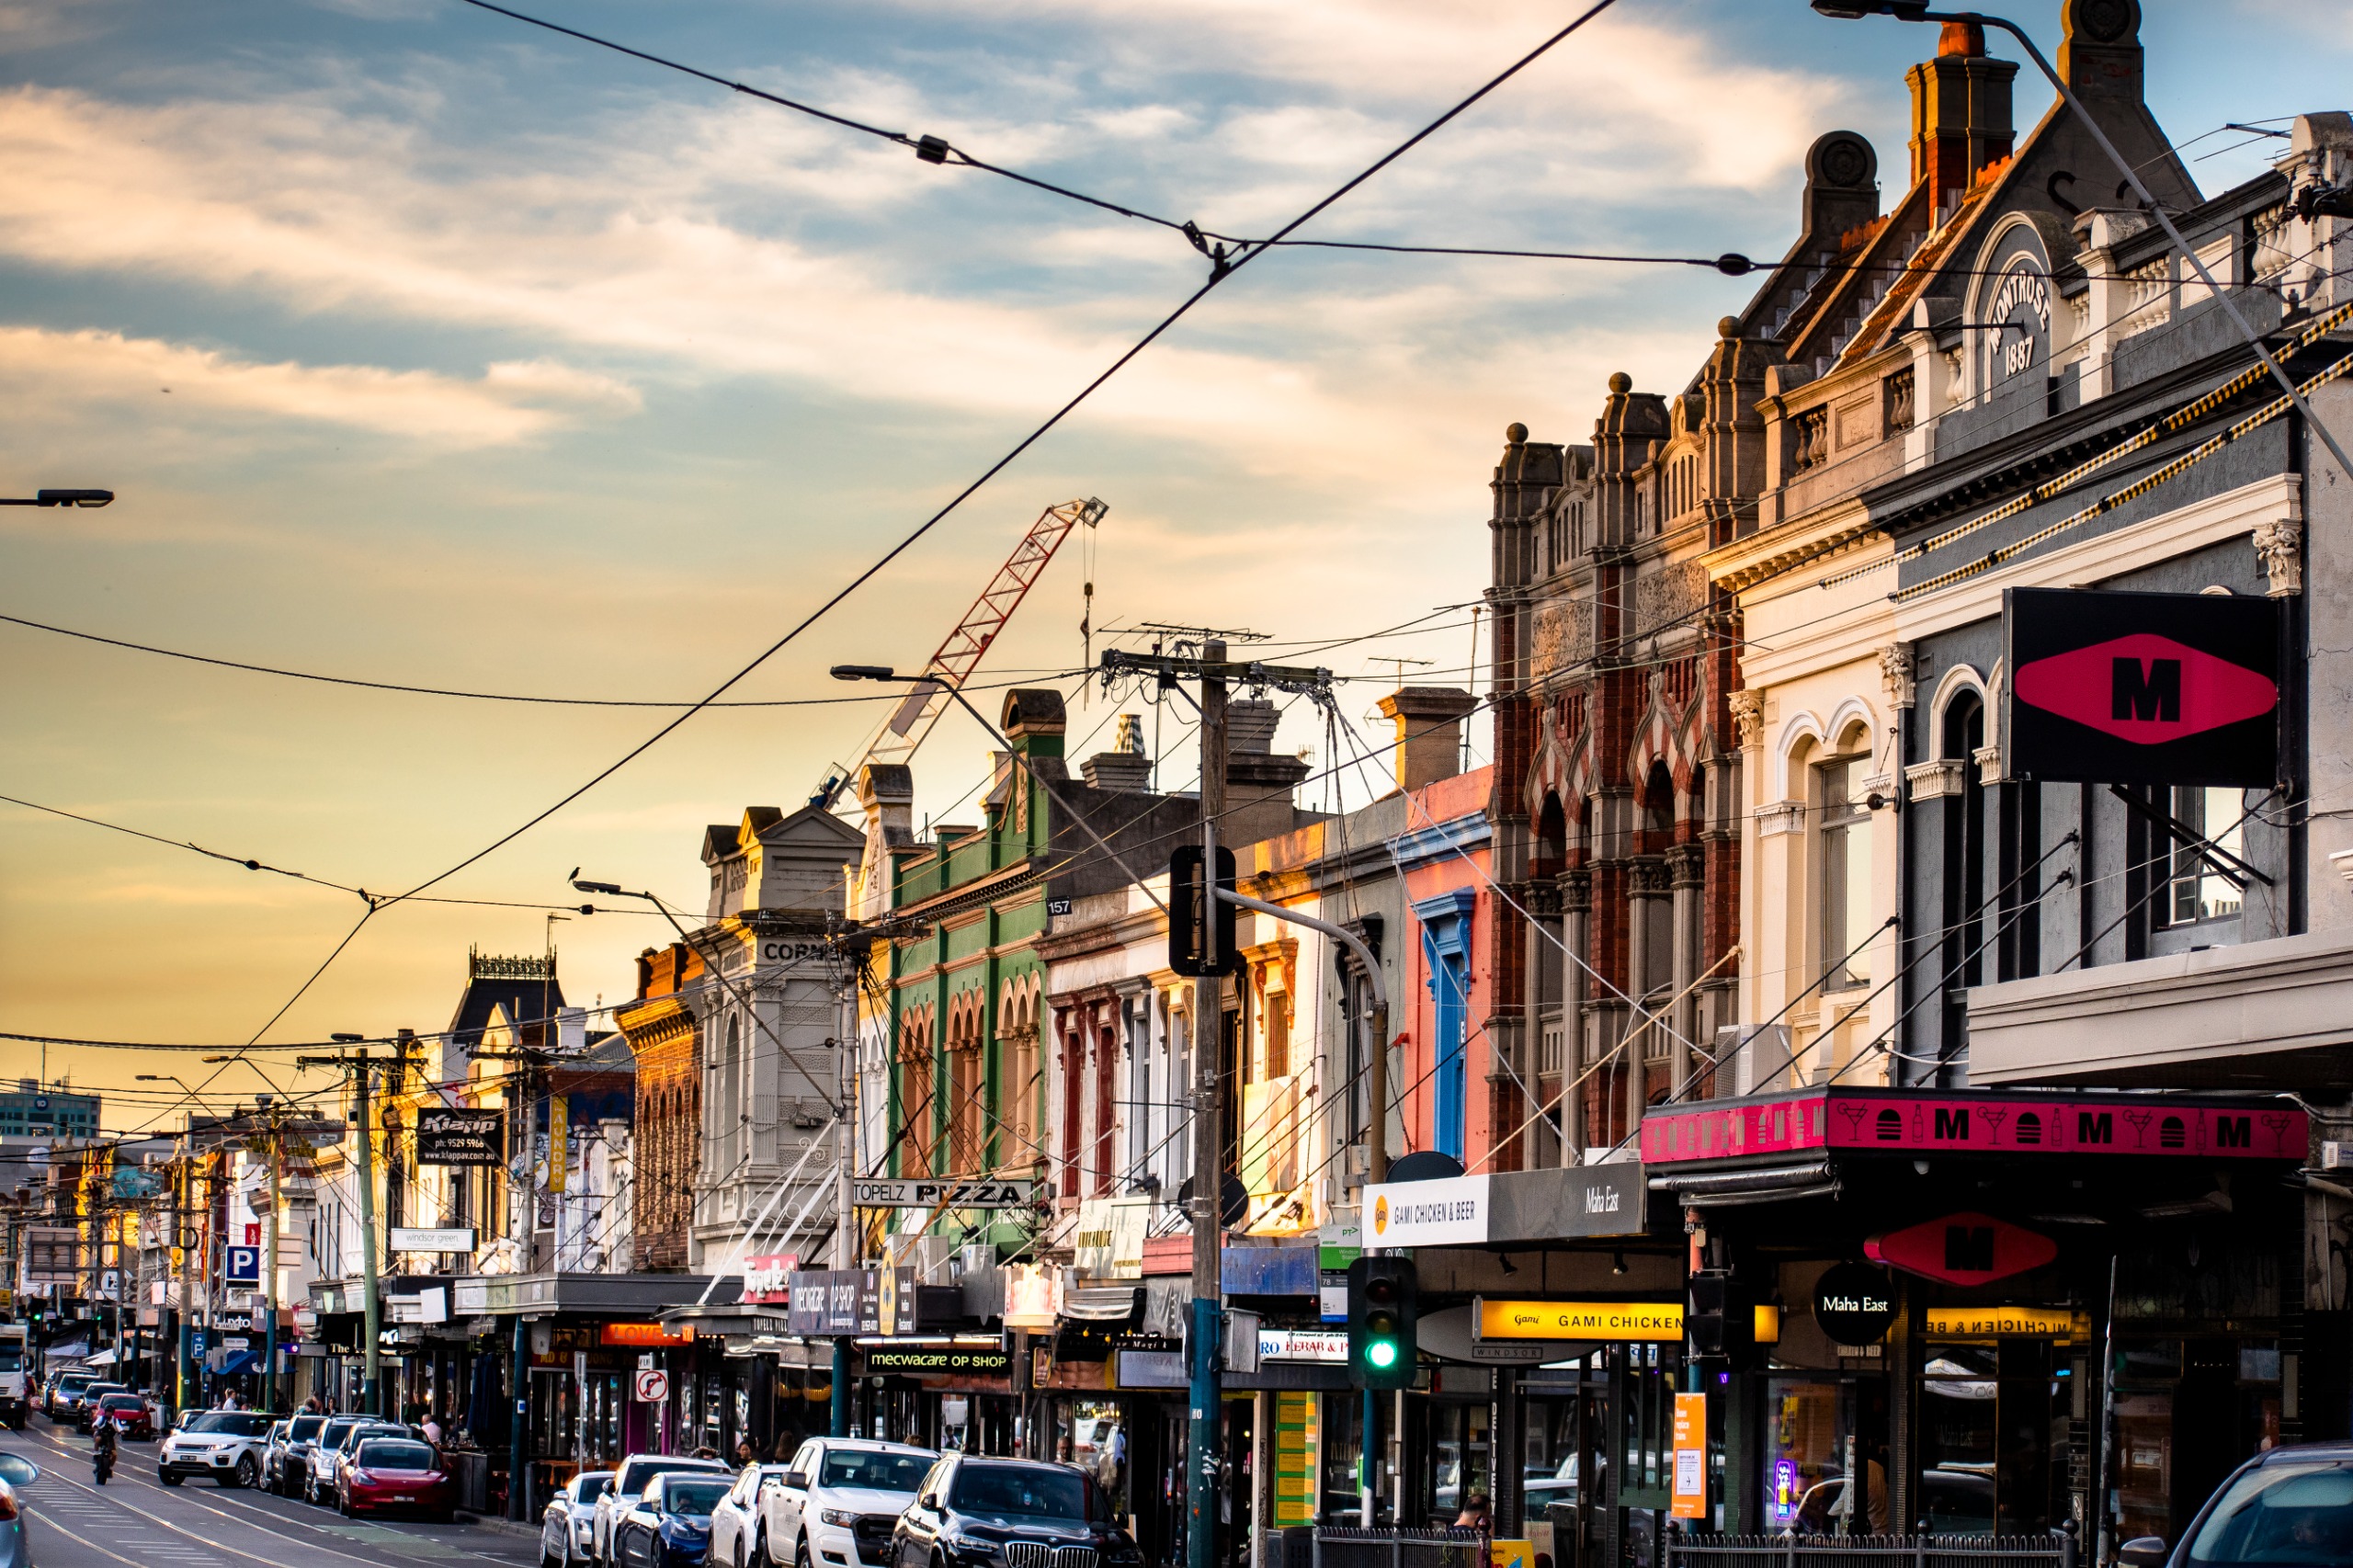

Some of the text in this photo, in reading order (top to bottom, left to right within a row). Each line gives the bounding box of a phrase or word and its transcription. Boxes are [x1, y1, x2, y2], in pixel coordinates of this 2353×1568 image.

[1990, 269, 2050, 355] MONTROSE
[2006, 335, 2034, 376] 1887
[2112, 657, 2181, 722] M
[1048, 900, 1070, 914] 157
[421, 1114, 496, 1134] Klapp
[1935, 1108, 1969, 1141] M
[2078, 1112, 2112, 1144] M
[2217, 1116, 2251, 1148] M
[854, 1184, 1021, 1202] TOPELZ PIZZA
[1585, 1186, 1619, 1214] Maha East
[1394, 1200, 1475, 1225] GAMI CHICKEN & BEER
[406, 1233, 435, 1242] windsor
[1944, 1226, 1995, 1272] M
[233, 1250, 254, 1276] P
[794, 1286, 825, 1312] mecwacare
[839, 1285, 855, 1312] SHOP
[1823, 1297, 1888, 1312] Maha East
[1514, 1313, 1540, 1327] Gami
[1559, 1315, 1602, 1327] GAMI
[331, 1343, 350, 1354] The
[1286, 1341, 1324, 1352] KEBAB
[1327, 1342, 1336, 1353] &
[1476, 1348, 1537, 1358] WINDSOR
[871, 1354, 1006, 1367] mecwacare OP SHOP
